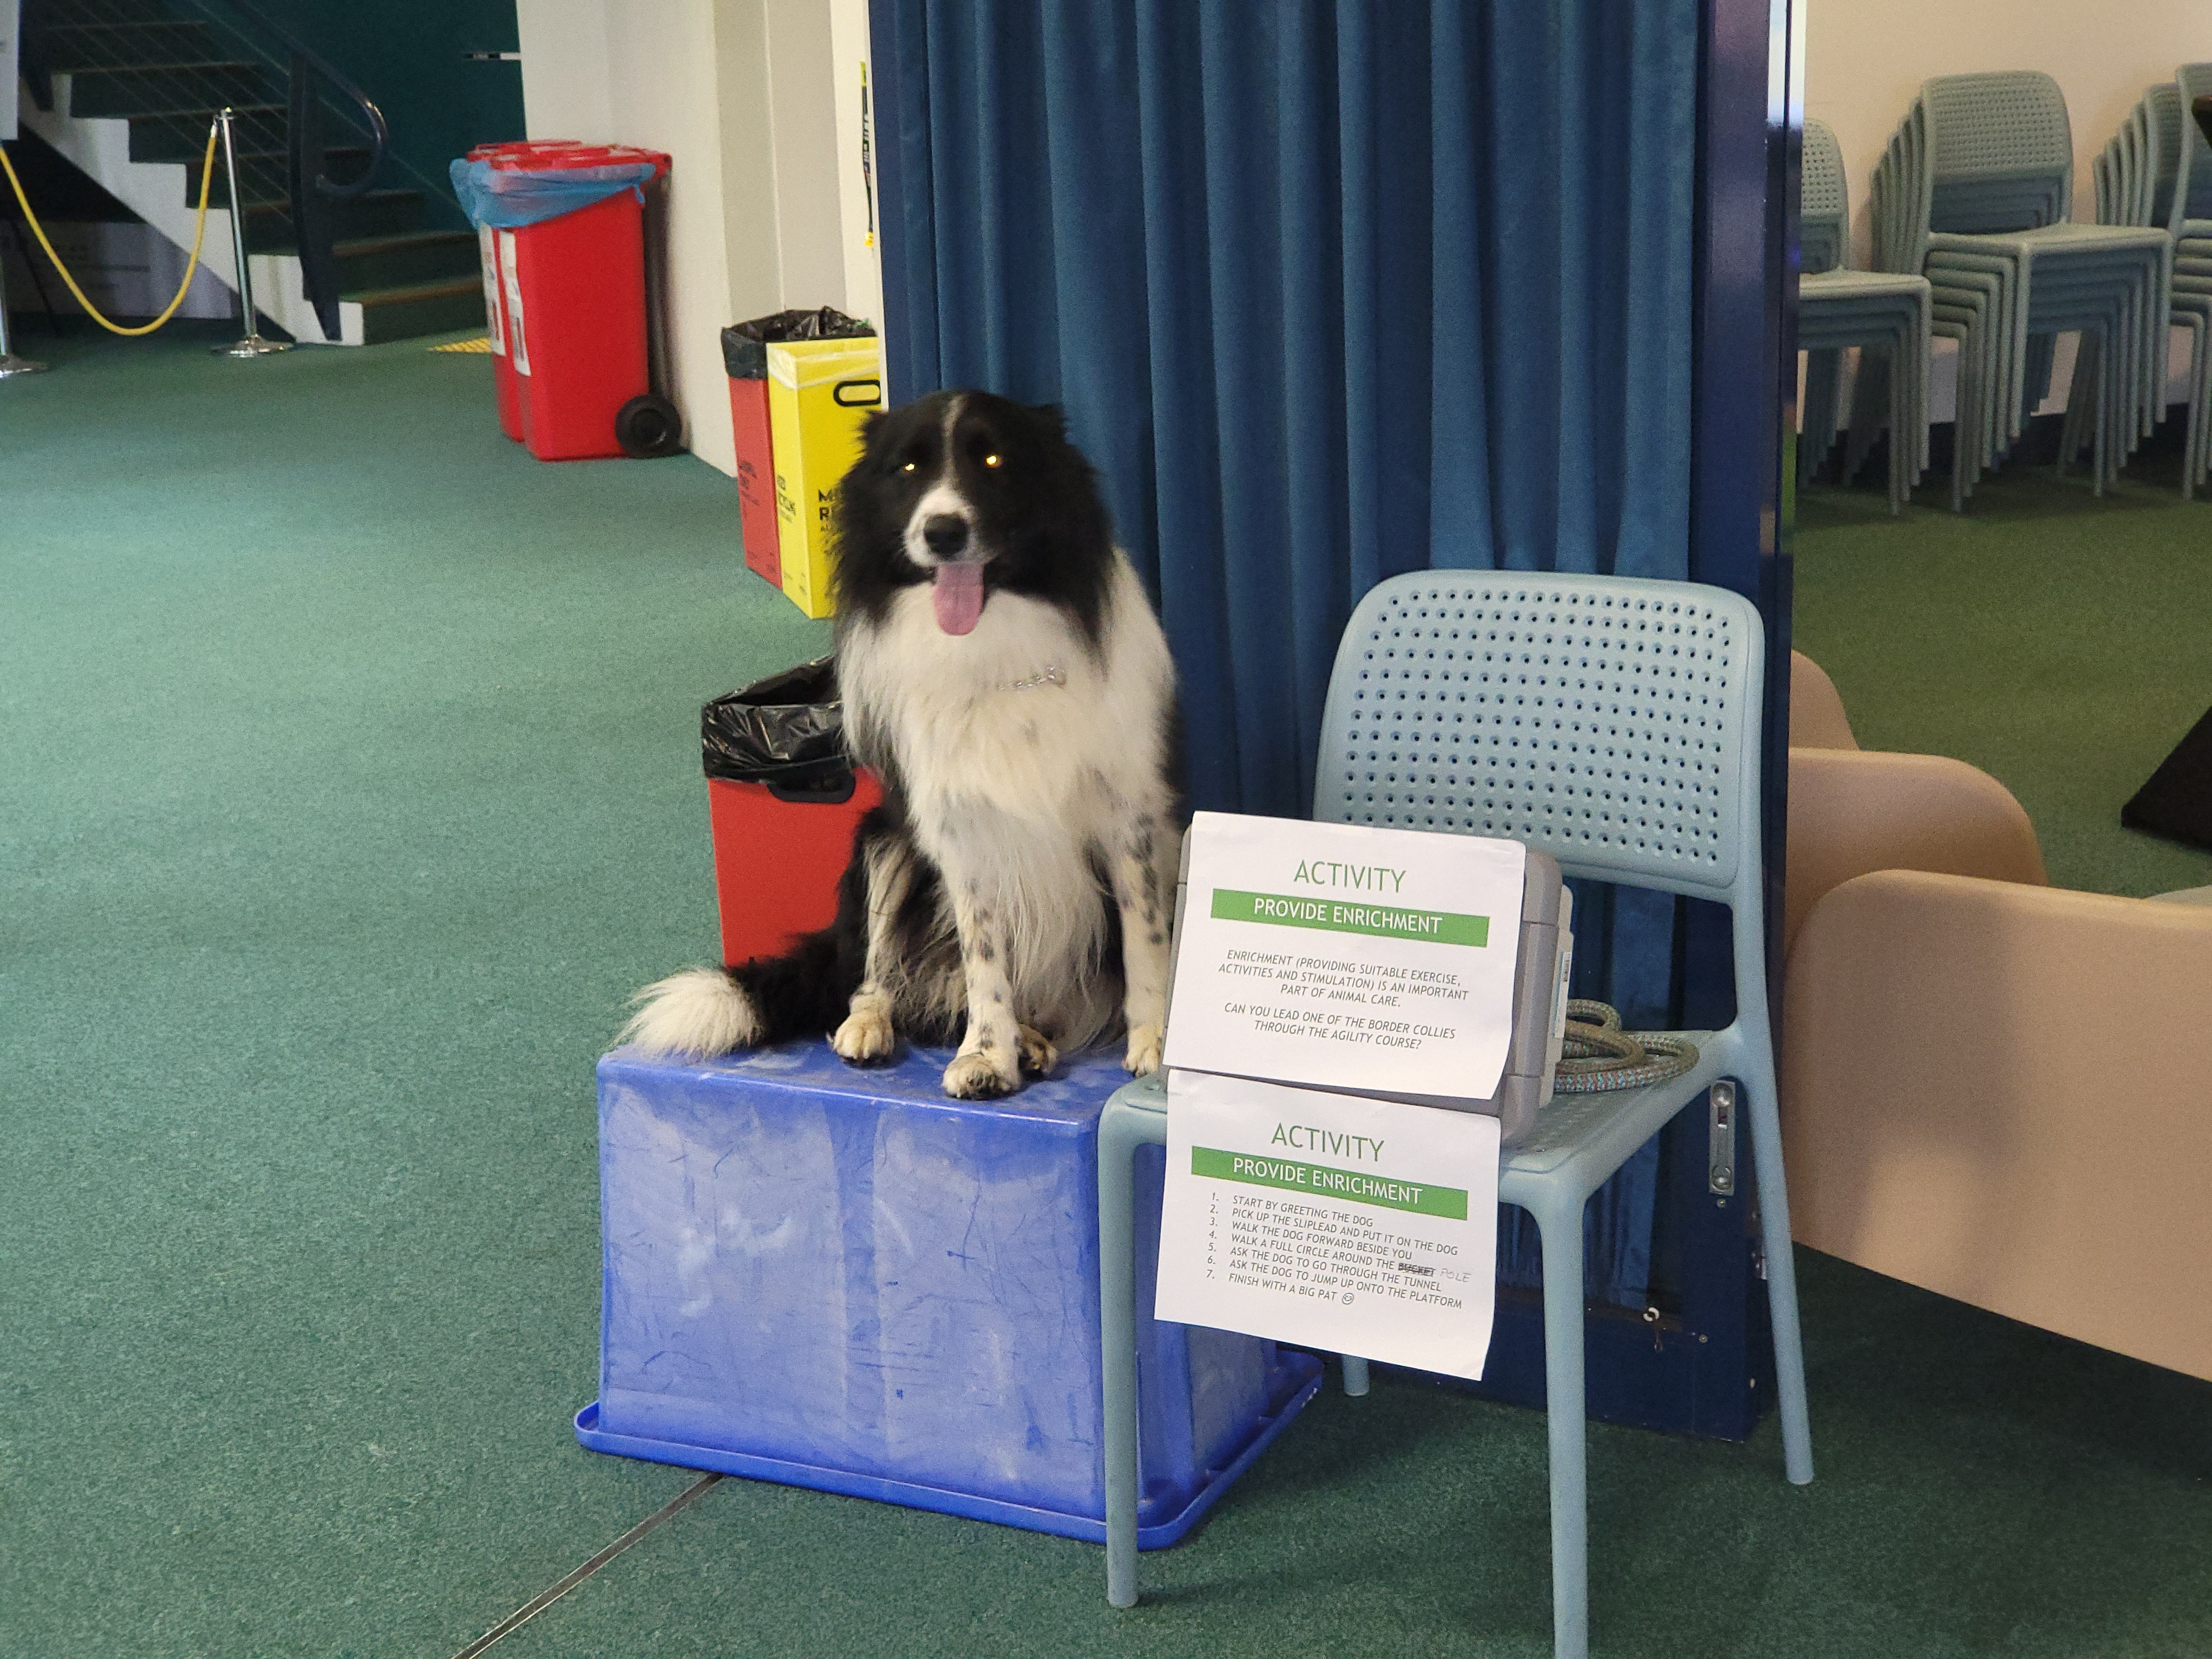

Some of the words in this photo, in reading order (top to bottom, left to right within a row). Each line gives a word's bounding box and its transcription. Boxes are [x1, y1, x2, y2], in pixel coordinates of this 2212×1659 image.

[1293, 859, 1406, 893] ACTIVITY
[1254, 898, 1327, 921] PROVIDE
[1333, 906, 1443, 933] ENRICHMENT
[1218, 963, 1273, 978] ACTIVITIES
[1275, 970, 1298, 980] AND
[1301, 972, 1374, 991] STIMULATION)
[1378, 980, 1387, 991] IS
[1390, 982, 1405, 993] AN
[1408, 984, 1469, 1000] IMPORTANT
[1227, 950, 1293, 966] ENRICHMENT
[1296, 957, 1355, 973] (PROVIDING
[1359, 964, 1408, 979] SUITABLE
[1411, 970, 1460, 987] EXERCISE,
[1280, 984, 1308, 996] PART
[1311, 987, 1326, 998] OF
[1327, 990, 1366, 1003] ANIMAL
[1371, 994, 1400, 1007] CARE.
[1224, 1003, 1246, 1014] CAN
[1250, 1005, 1271, 1017] YOU
[1273, 1008, 1300, 1020] LEAD
[1302, 1011, 1324, 1024] ONE
[1327, 1014, 1342, 1025] OF
[1345, 1016, 1366, 1028] THE
[1368, 1019, 1410, 1034] BORDER
[1413, 1025, 1456, 1039] COLLIES
[1255, 1020, 1305, 1035] THROUGH
[1309, 1026, 1329, 1039] THE
[1331, 1030, 1373, 1043] AGILITY
[1375, 1035, 1422, 1050] COURSE?
[1271, 1123, 1385, 1162] ACTIVITY
[1234, 1157, 1306, 1184] PROVIDE
[1312, 1170, 1423, 1204] ENRICHMENT
[1212, 1192, 1219, 1201] 1.
[1233, 1195, 1264, 1208] START
[1265, 1200, 1279, 1210] BY
[1280, 1203, 1328, 1219] GREETING
[1332, 1211, 1350, 1223] THE
[1353, 1215, 1373, 1227] DOG
[1209, 1217, 1218, 1227] 3.
[1232, 1221, 1259, 1233] WALK
[1261, 1225, 1280, 1237] THE
[1282, 1229, 1303, 1241] DOG
[1306, 1233, 1354, 1249] FORWARD
[1356, 1241, 1389, 1256] BESIDE
[1392, 1248, 1412, 1260] YOU
[1210, 1204, 1218, 1214] 2.
[1232, 1208, 1254, 1219] PICK
[1256, 1212, 1269, 1222] UP
[1272, 1214, 1291, 1226] THE
[1293, 1218, 1337, 1233] SLIPLEAD
[1339, 1227, 1360, 1237] AND
[1362, 1230, 1383, 1241] PUT
[1384, 1234, 1395, 1244] IT
[1396, 1237, 1411, 1247] ON
[1414, 1239, 1434, 1251] THE
[1436, 1243, 1458, 1256] DOG
[1208, 1242, 1216, 1252] 5.
[1230, 1246, 1248, 1257] ASK
[1251, 1249, 1270, 1261] THE
[1272, 1253, 1293, 1265] DOG
[1296, 1257, 1310, 1268] TO
[1312, 1260, 1327, 1271] GO
[1331, 1263, 1378, 1280] THROUGH
[1381, 1272, 1401, 1284] THE
[1404, 1276, 1441, 1292] TUNNEL
[1209, 1230, 1217, 1239] 4.
[1232, 1233, 1258, 1246] WALK
[1260, 1239, 1266, 1248] A
[1270, 1240, 1293, 1253] FULL
[1296, 1244, 1330, 1258] CIRCLE
[1332, 1251, 1372, 1265] AROUND
[1376, 1258, 1396, 1270] THE
[1207, 1255, 1215, 1265] 6.
[1229, 1259, 1248, 1270] ASK
[1251, 1262, 1270, 1274] THE
[1271, 1266, 1292, 1278] DOG
[1296, 1270, 1309, 1281] TO
[1311, 1274, 1338, 1285] JUMP
[1340, 1278, 1354, 1288] UP
[1356, 1281, 1384, 1295] ONTO
[1388, 1286, 1407, 1299] THE
[1409, 1290, 1462, 1309] PLATFORM
[1207, 1269, 1215, 1279] 7.
[1229, 1273, 1259, 1286] FINISH
[1262, 1279, 1287, 1291] WITH
[1288, 1285, 1295, 1293] A
[1298, 1286, 1315, 1297] BIG
[1318, 1289, 1338, 1301] PAT
[1440, 1267, 1472, 1282] POLE
